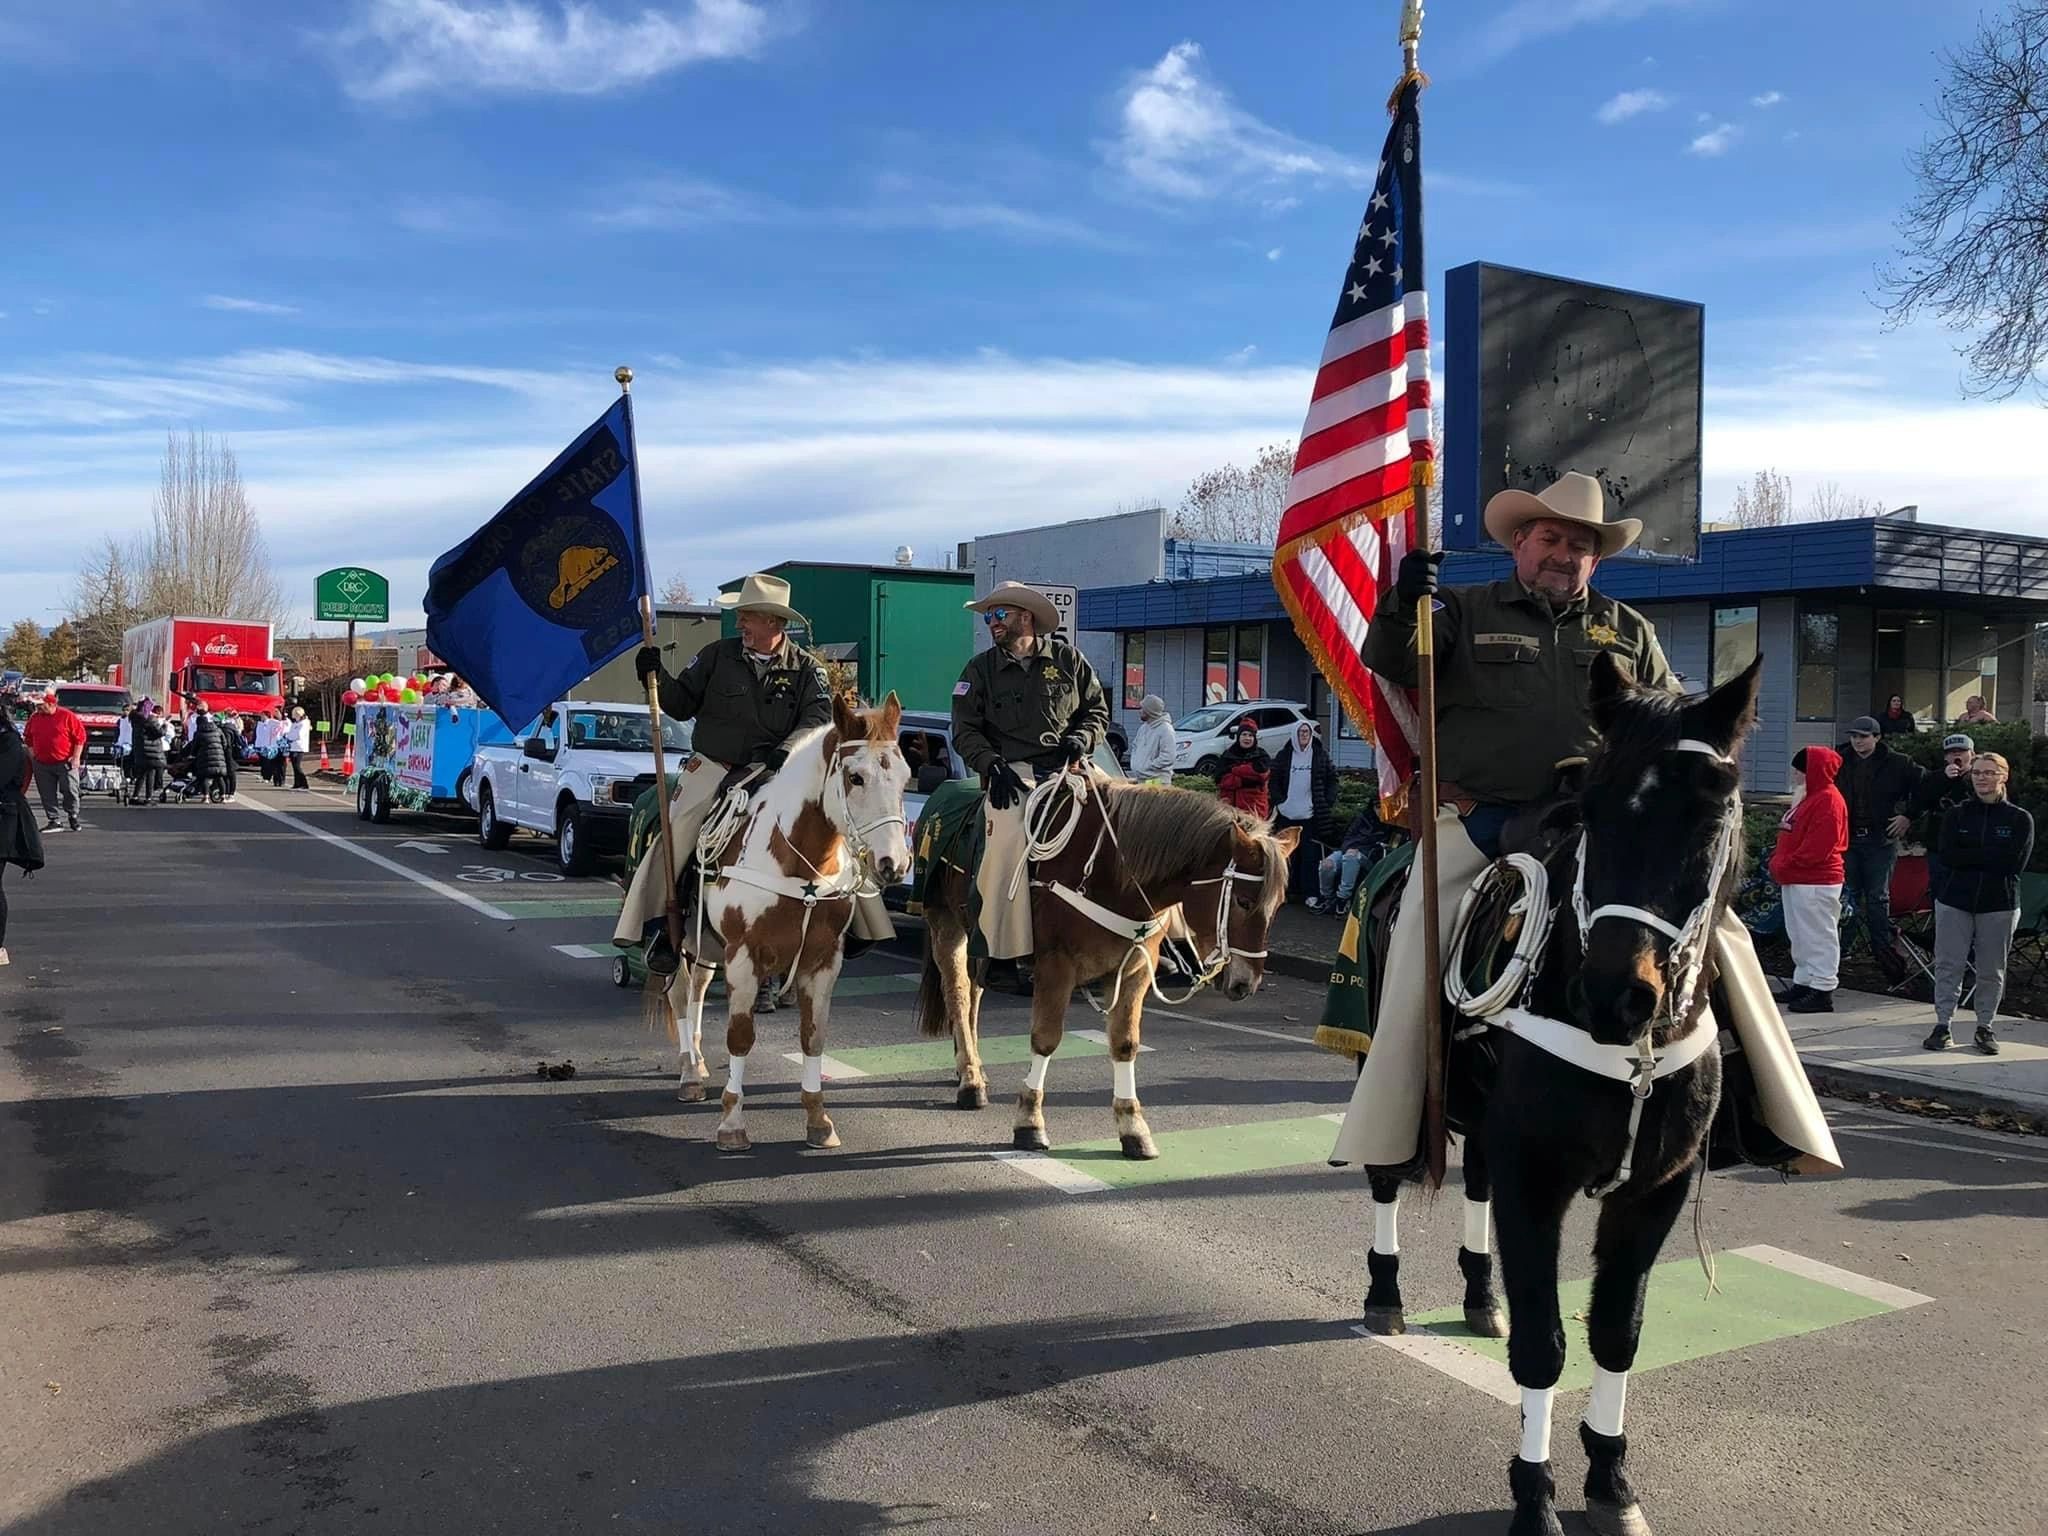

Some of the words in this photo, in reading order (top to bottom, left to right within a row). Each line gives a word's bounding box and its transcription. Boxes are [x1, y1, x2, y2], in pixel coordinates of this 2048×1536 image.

[1046, 593, 1072, 606] EED
[321, 602, 348, 612] DEEP
[1330, 972, 1344, 984] ED
[1350, 975, 1366, 989] PO
